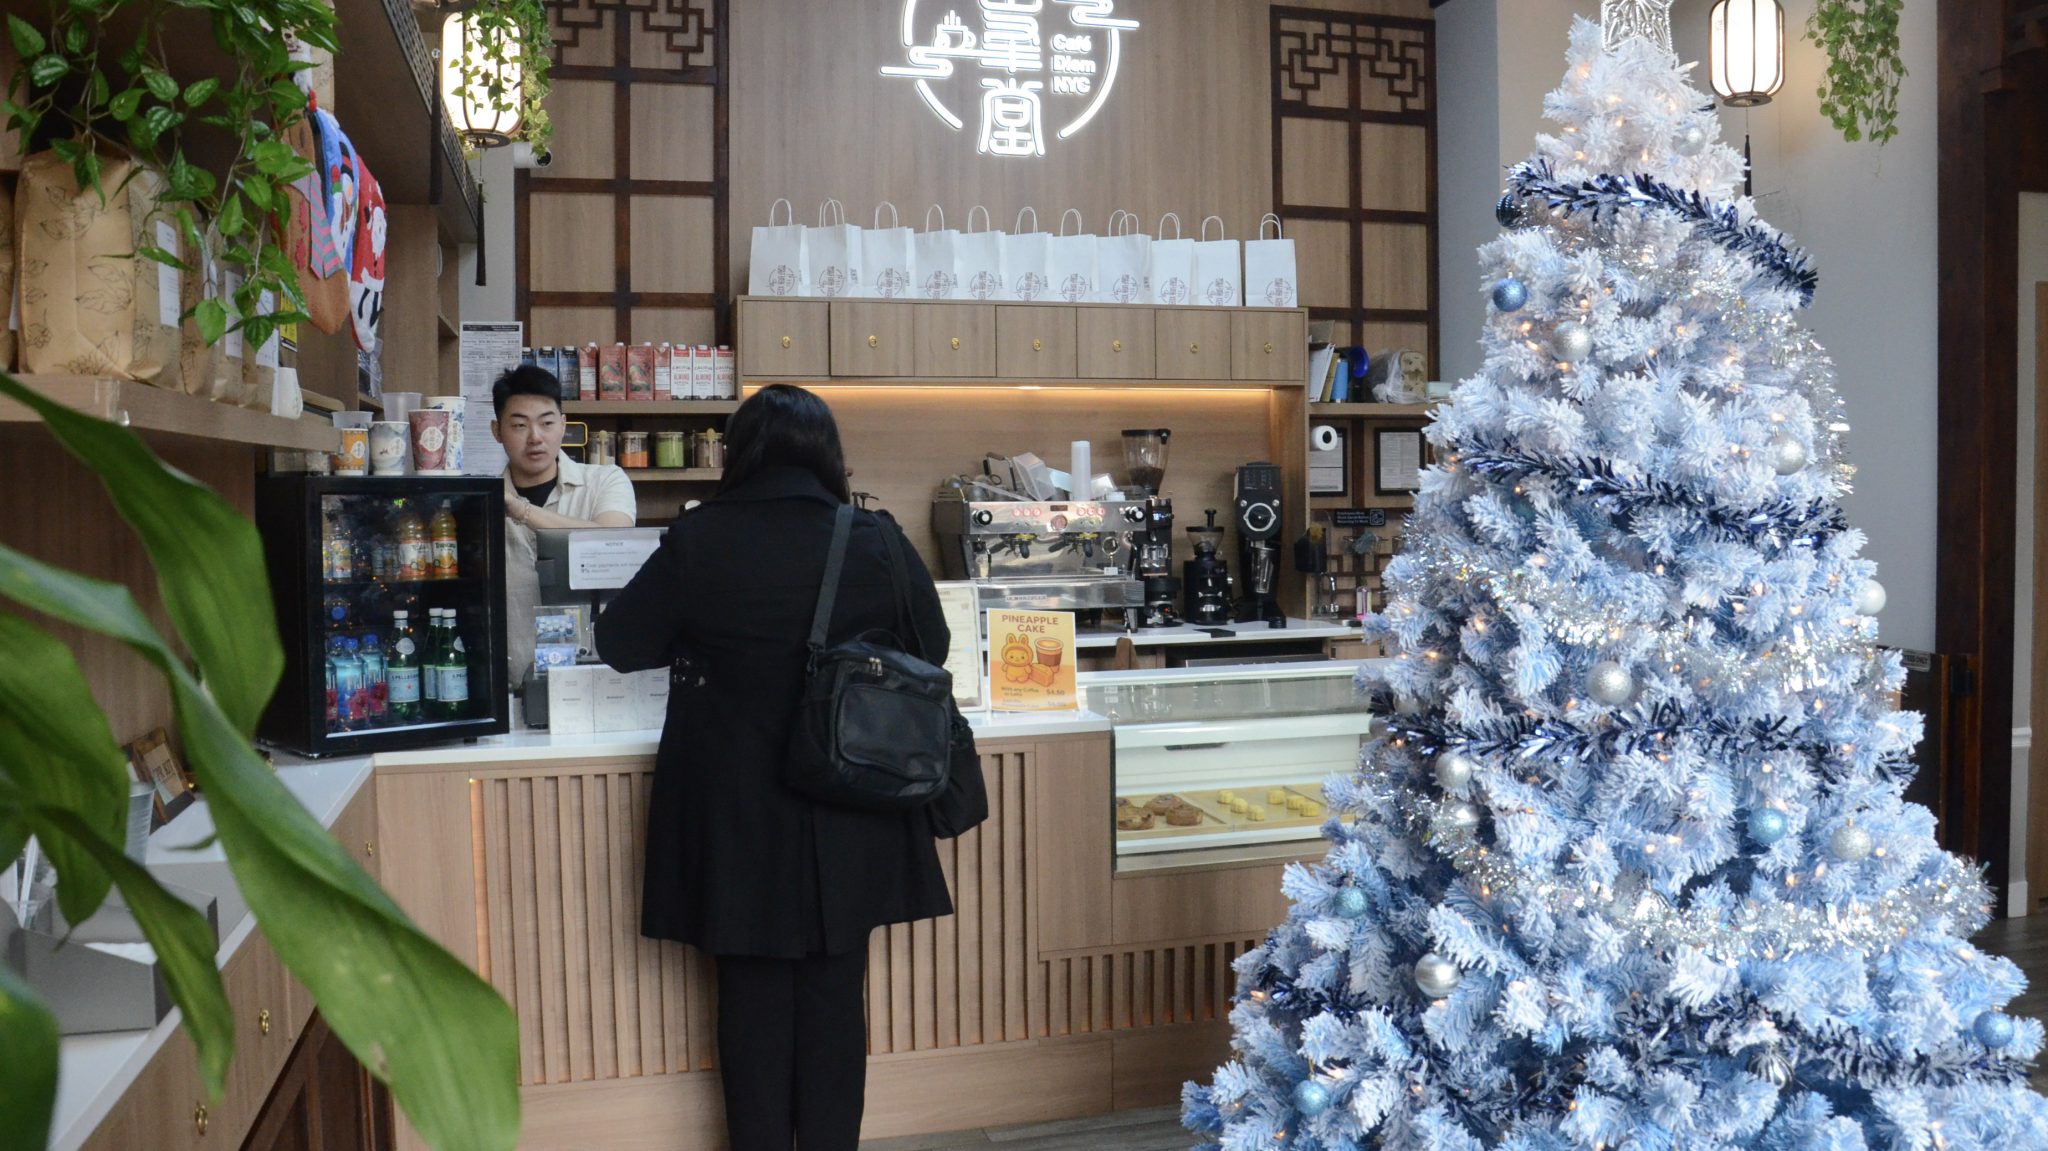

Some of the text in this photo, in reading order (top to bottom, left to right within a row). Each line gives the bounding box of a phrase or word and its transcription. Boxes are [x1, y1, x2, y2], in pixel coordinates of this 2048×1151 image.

[1052, 34, 1092, 52] Café
[1052, 55, 1096, 73] Diem
[1052, 76, 1091, 93] NYC
[1001, 614, 1059, 625] PINEAPPLE
[1017, 624, 1046, 633] CAKE
